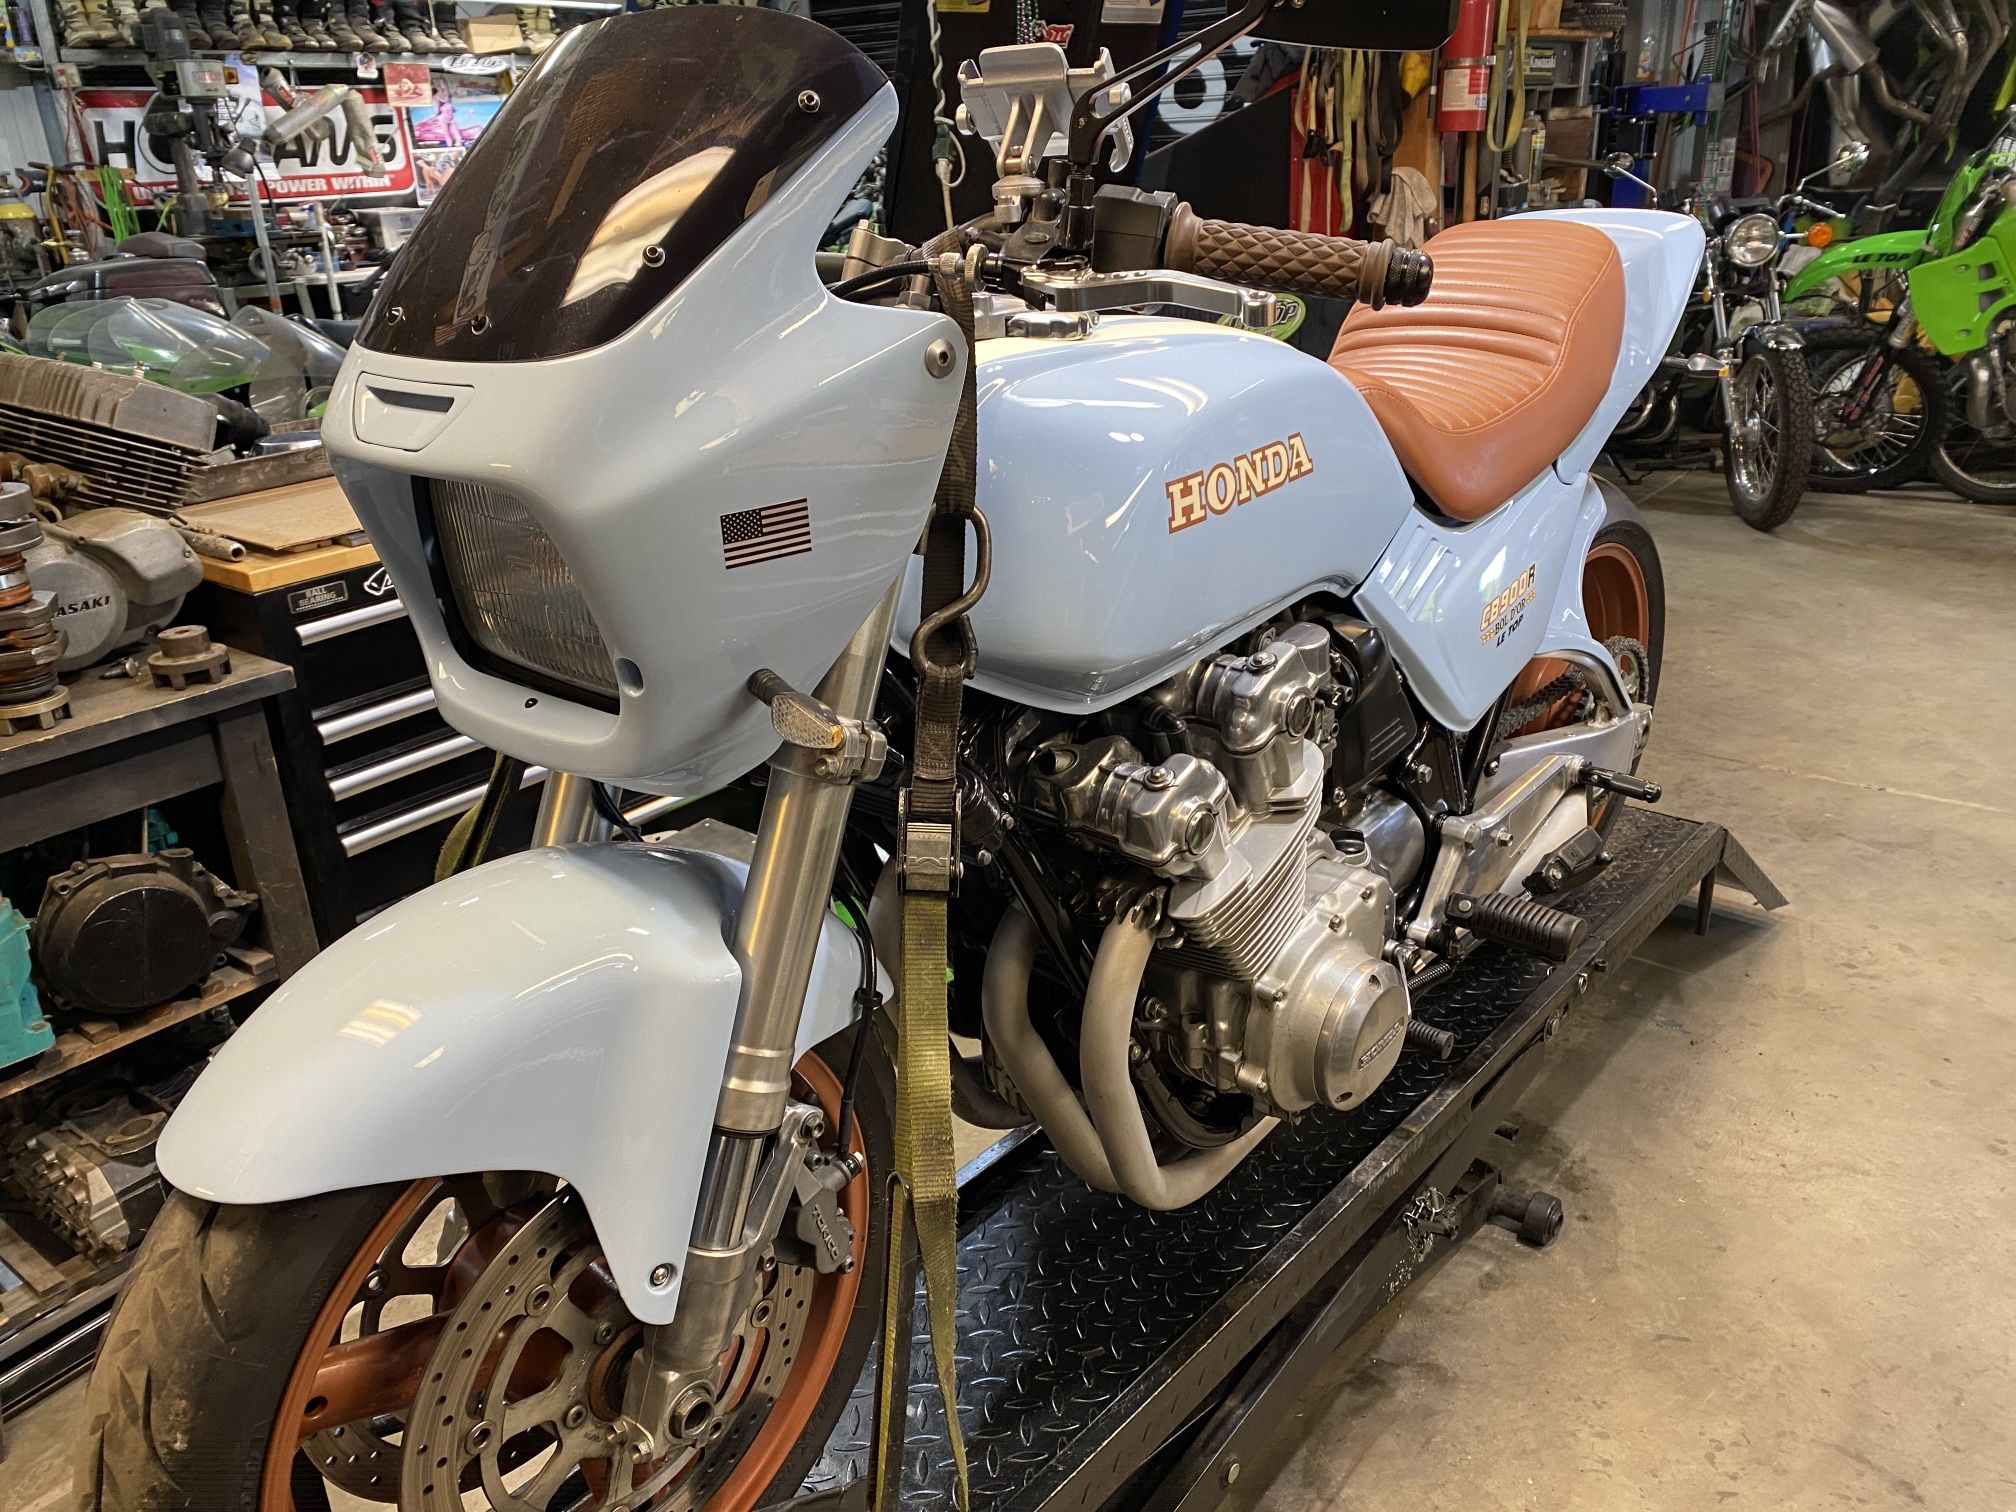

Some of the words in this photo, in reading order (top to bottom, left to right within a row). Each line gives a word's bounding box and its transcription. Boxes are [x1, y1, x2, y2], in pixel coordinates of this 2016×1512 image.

[268, 179, 326, 193] POWER
[1853, 254, 1872, 263] LE
[1876, 252, 1911, 263] TOP
[1166, 433, 1313, 533] HONDA
[56, 595, 110, 618] ASAKI
[298, 591, 337, 607] BEARING
[305, 586, 328, 599] BALL
[1480, 562, 1536, 632] CB900R
[1494, 614, 1509, 636] BOL
[1510, 597, 1527, 621] D'OR
[1496, 631, 1507, 648] LE
[1508, 614, 1525, 637] TOP
[1359, 1019, 1403, 1069] HONDA
[812, 1203, 839, 1262] TOKICO
